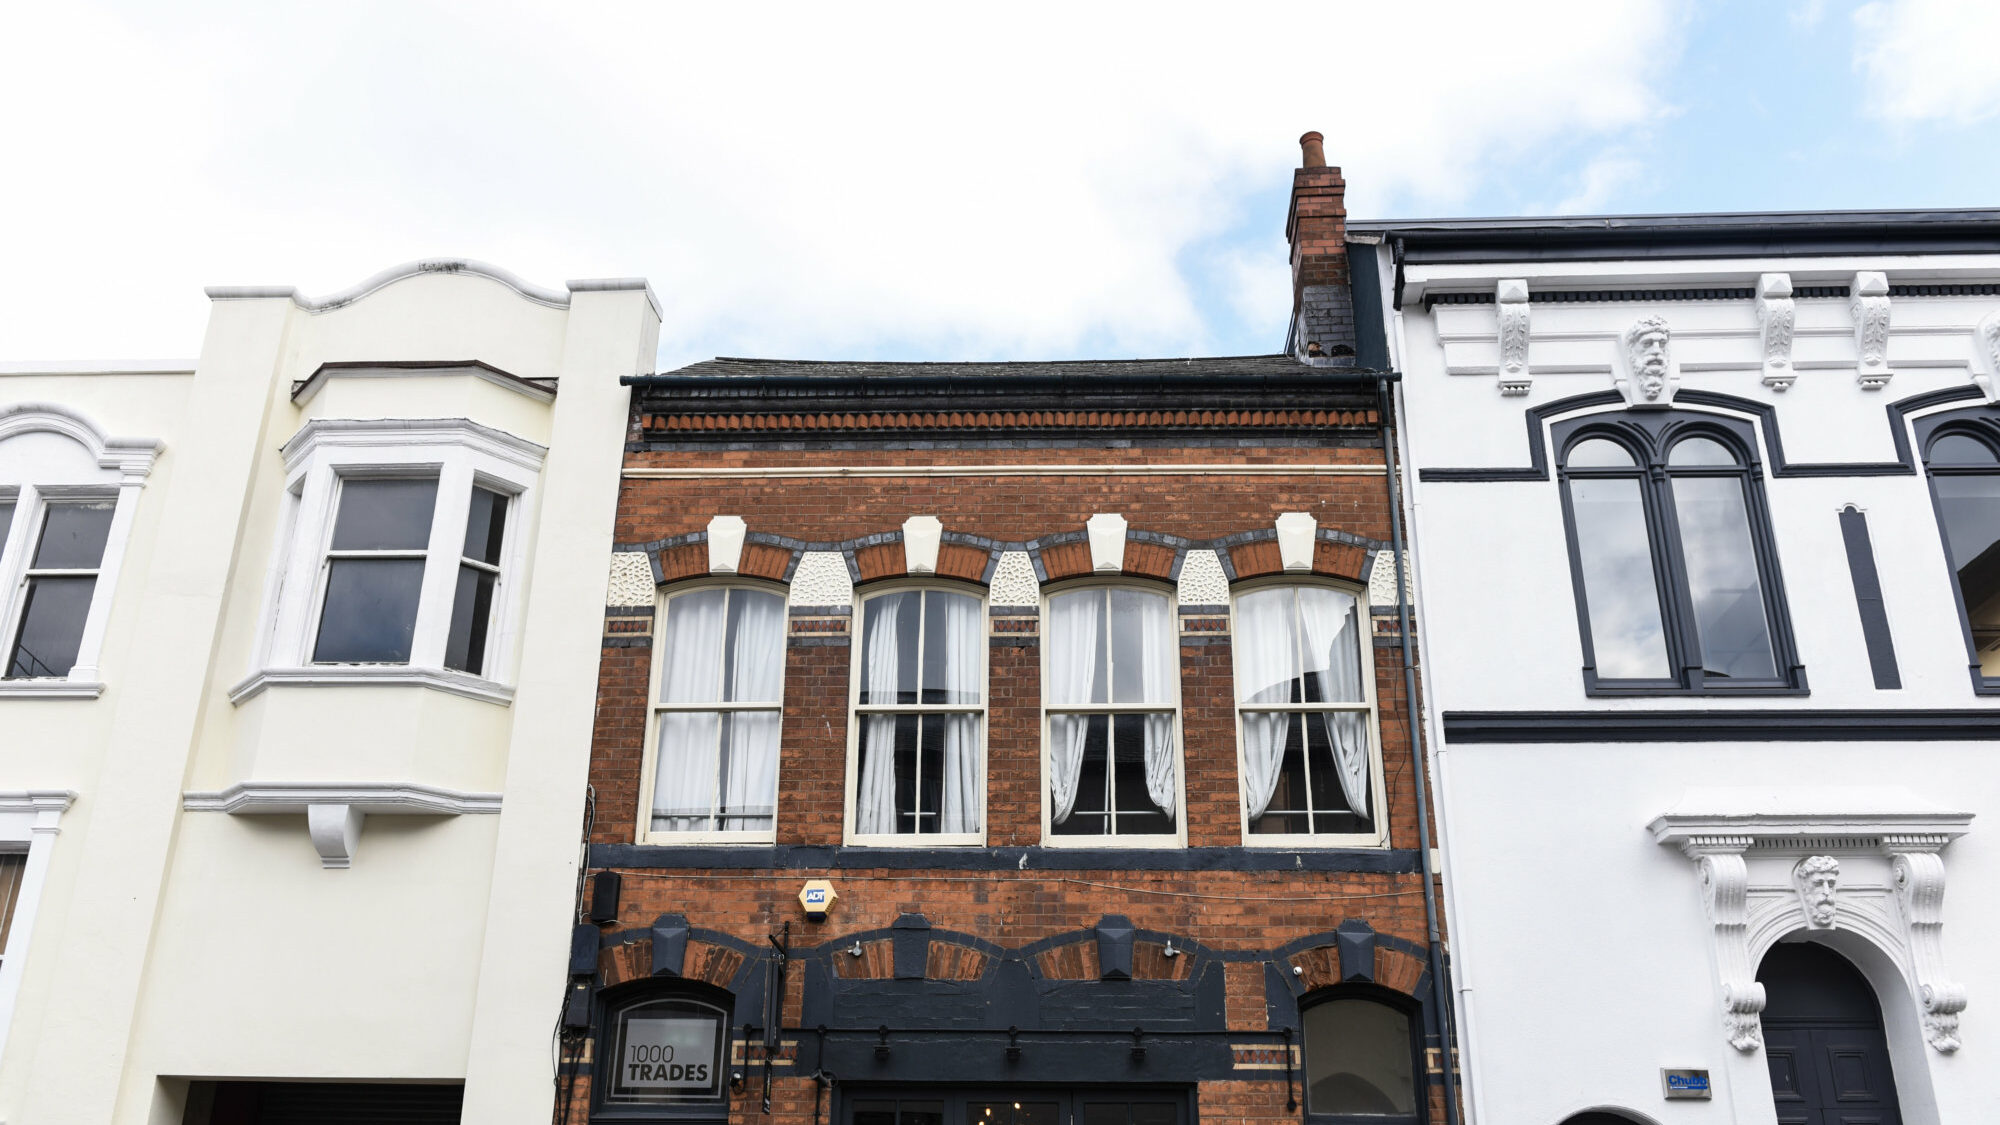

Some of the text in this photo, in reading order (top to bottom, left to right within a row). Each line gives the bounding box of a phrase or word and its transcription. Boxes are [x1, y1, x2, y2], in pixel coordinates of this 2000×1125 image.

[807, 891, 824, 900] ADT
[630, 1045, 674, 1063] 1000
[628, 1064, 708, 1081] TRADES
[1668, 1074, 1707, 1085] Chubb
